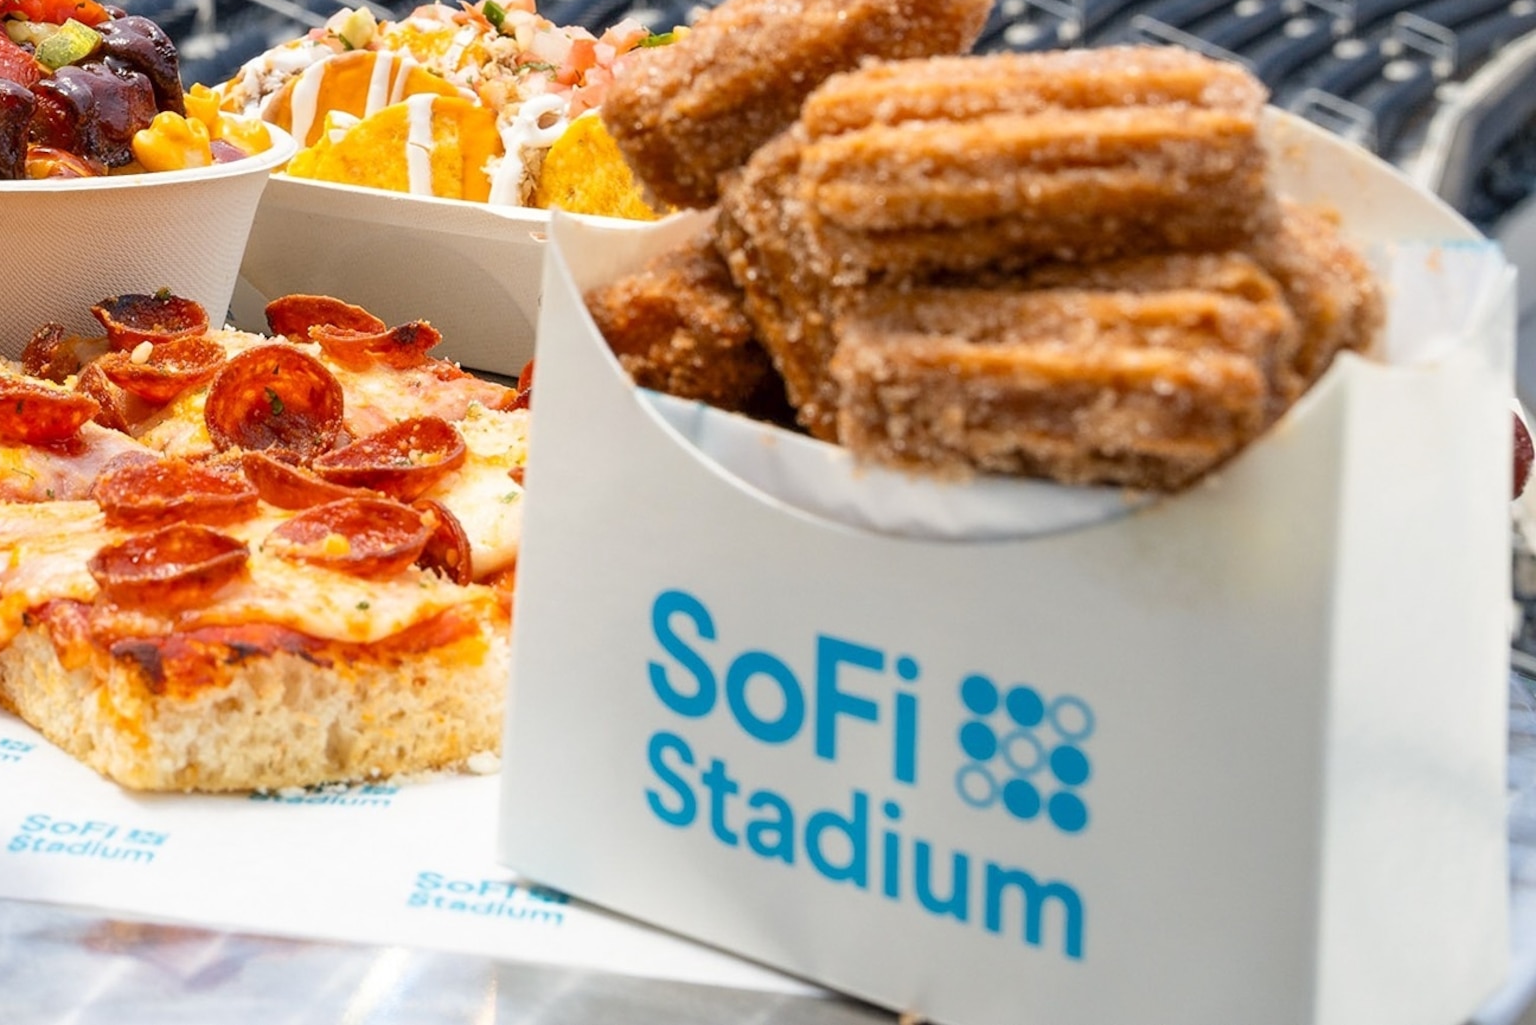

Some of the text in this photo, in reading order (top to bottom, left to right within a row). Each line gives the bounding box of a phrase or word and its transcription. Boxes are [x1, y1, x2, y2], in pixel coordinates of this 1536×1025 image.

[647, 589, 919, 787] SoFi
[19, 814, 120, 842] SoFi
[7, 834, 156, 864] Stadium
[644, 730, 1085, 961] Stadium
[406, 892, 565, 926] Stadium
